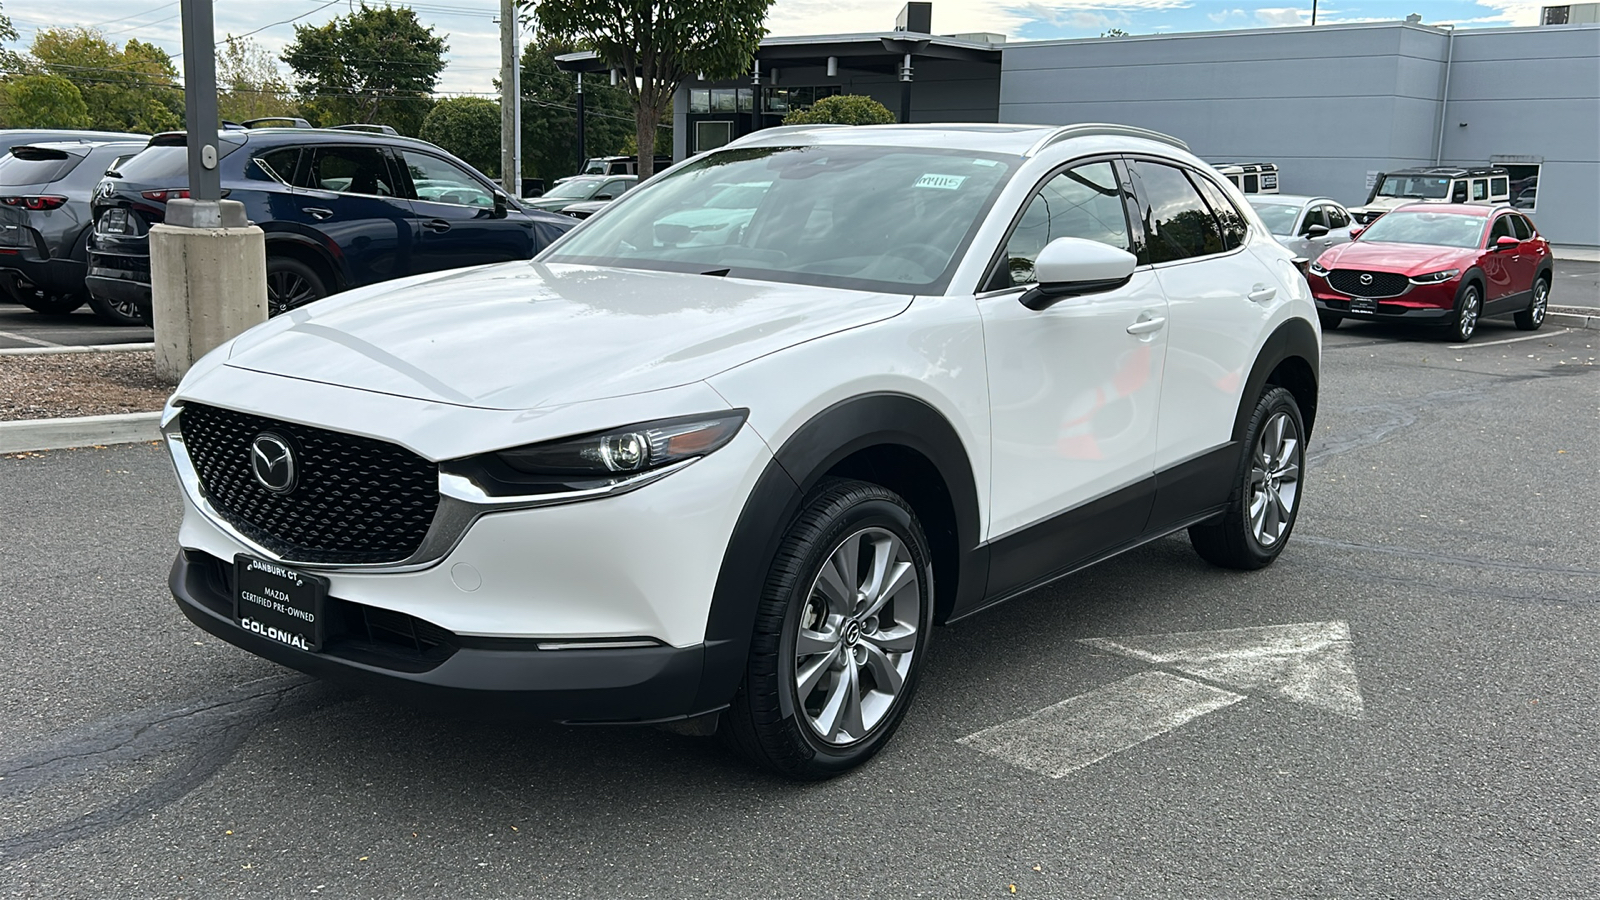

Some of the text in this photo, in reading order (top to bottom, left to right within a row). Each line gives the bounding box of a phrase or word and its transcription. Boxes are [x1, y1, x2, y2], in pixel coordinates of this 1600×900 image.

[253, 560, 298, 580] DANBURY, CT
[241, 591, 315, 622] CERTIFIED PRE-OWNED
[264, 587, 290, 602] MAZDA
[241, 618, 309, 650] COLONIAL
